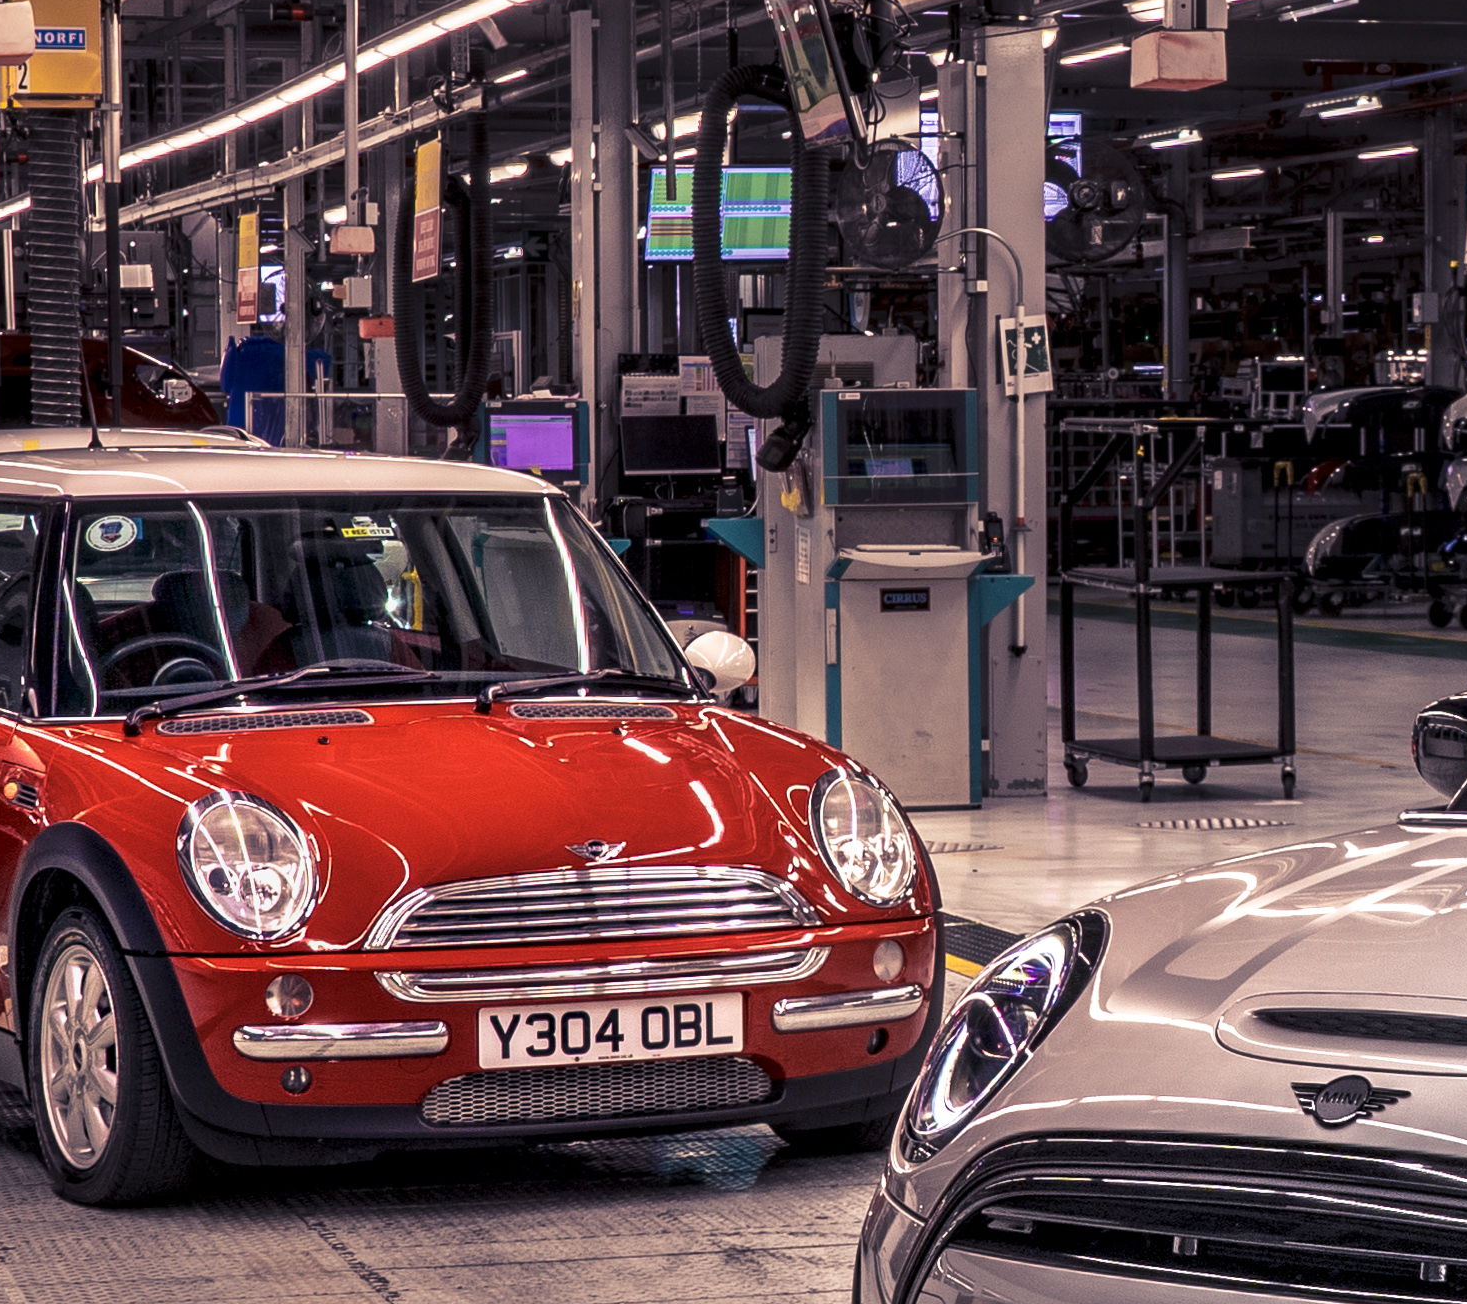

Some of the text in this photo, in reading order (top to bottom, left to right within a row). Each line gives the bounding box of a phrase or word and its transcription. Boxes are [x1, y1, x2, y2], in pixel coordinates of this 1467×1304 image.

[18, 62, 28, 90] 2
[883, 593, 928, 605] CIRRUS
[489, 1002, 734, 1060] Y304 OBL
[1320, 1091, 1363, 1106] MINI
